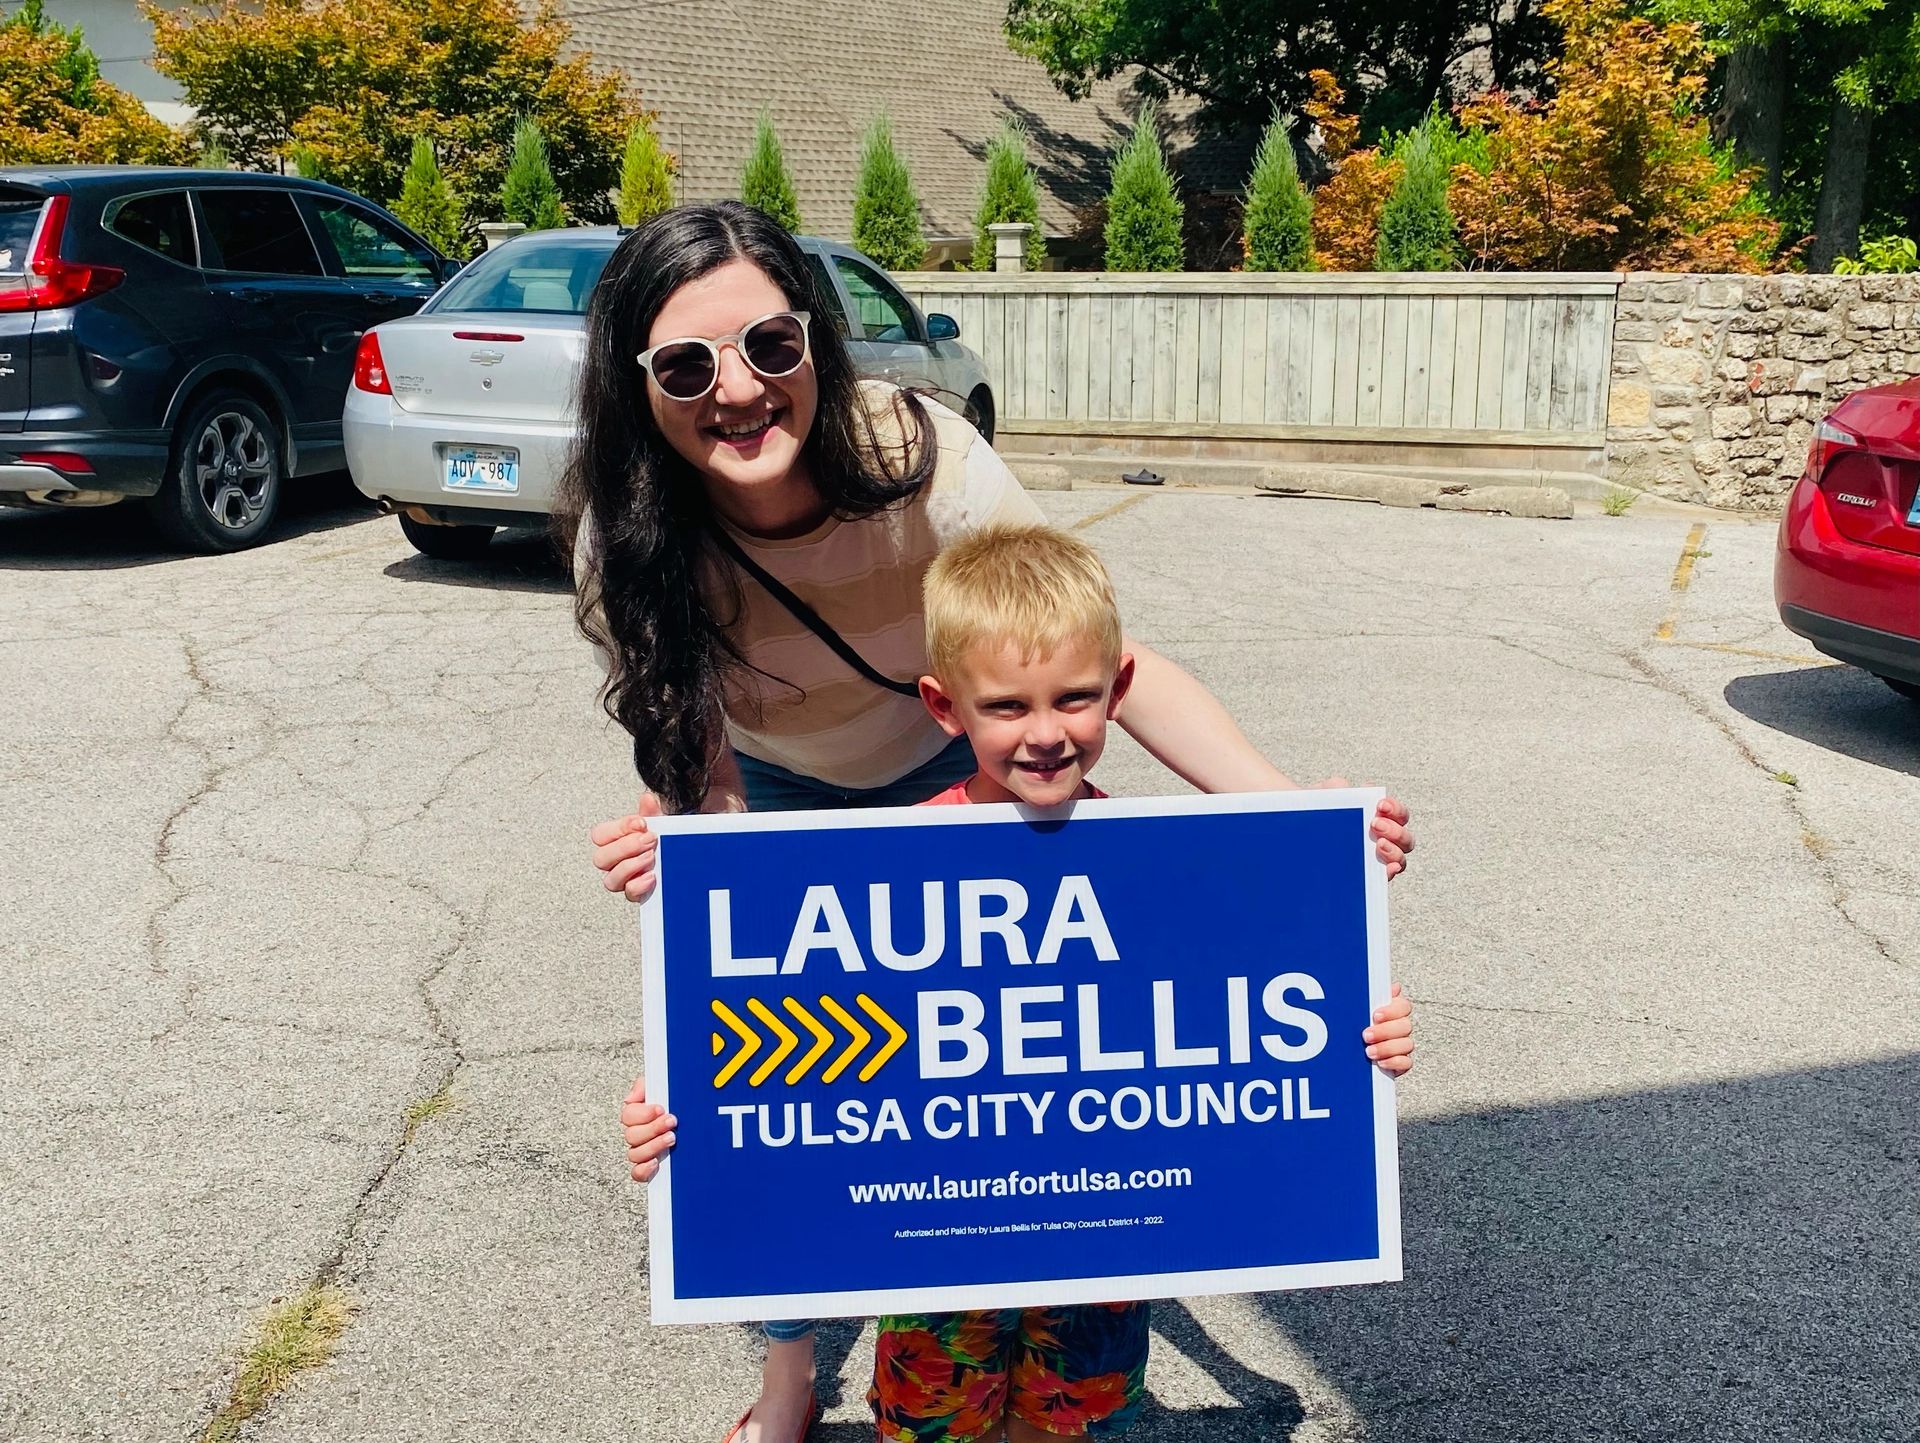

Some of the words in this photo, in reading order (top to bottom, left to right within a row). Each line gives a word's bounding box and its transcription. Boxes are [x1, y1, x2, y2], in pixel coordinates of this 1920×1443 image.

[465, 453, 499, 461] OKLAHOMA
[1837, 493, 1877, 507] COROLLA
[708, 875, 1121, 978] LAURA
[917, 972, 1328, 1079] BELLIS
[717, 1098, 912, 1148] TULSA
[923, 1091, 1056, 1140] CITY
[1068, 1077, 1330, 1132] COUNCIL
[848, 1167, 1193, 1203] www.laurafortulsa.com
[894, 1229, 934, 1238] Authorized
[935, 1228, 950, 1237] and
[951, 1226, 967, 1235] Paid
[968, 1226, 978, 1235] for
[979, 1226, 989, 1236] by
[989, 1224, 1010, 1234] Laura
[1011, 1223, 1031, 1232] Bellis
[1031, 1222, 1042, 1231] for
[1042, 1221, 1062, 1230] Tulsa
[1062, 1221, 1078, 1230] City
[1078, 1219, 1107, 1228] Council,
[1109, 1218, 1133, 1227] District
[1133, 1217, 1140, 1225] 4
